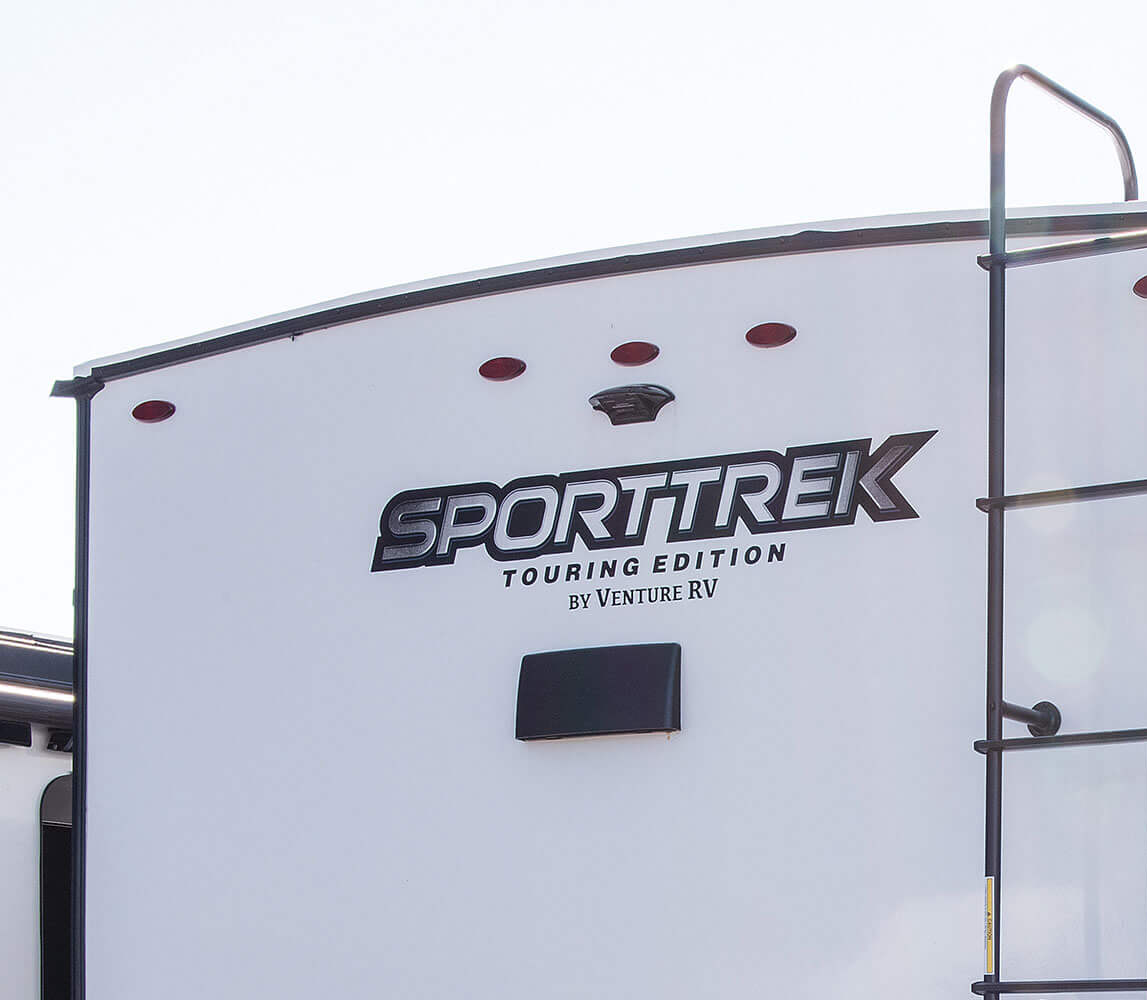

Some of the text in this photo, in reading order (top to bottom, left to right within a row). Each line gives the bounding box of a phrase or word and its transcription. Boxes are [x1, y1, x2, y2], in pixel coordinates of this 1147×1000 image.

[370, 430, 939, 573] SPORTTREK
[502, 543, 787, 588] TOURING EDITION
[568, 578, 719, 610] BY VENTURE RV
